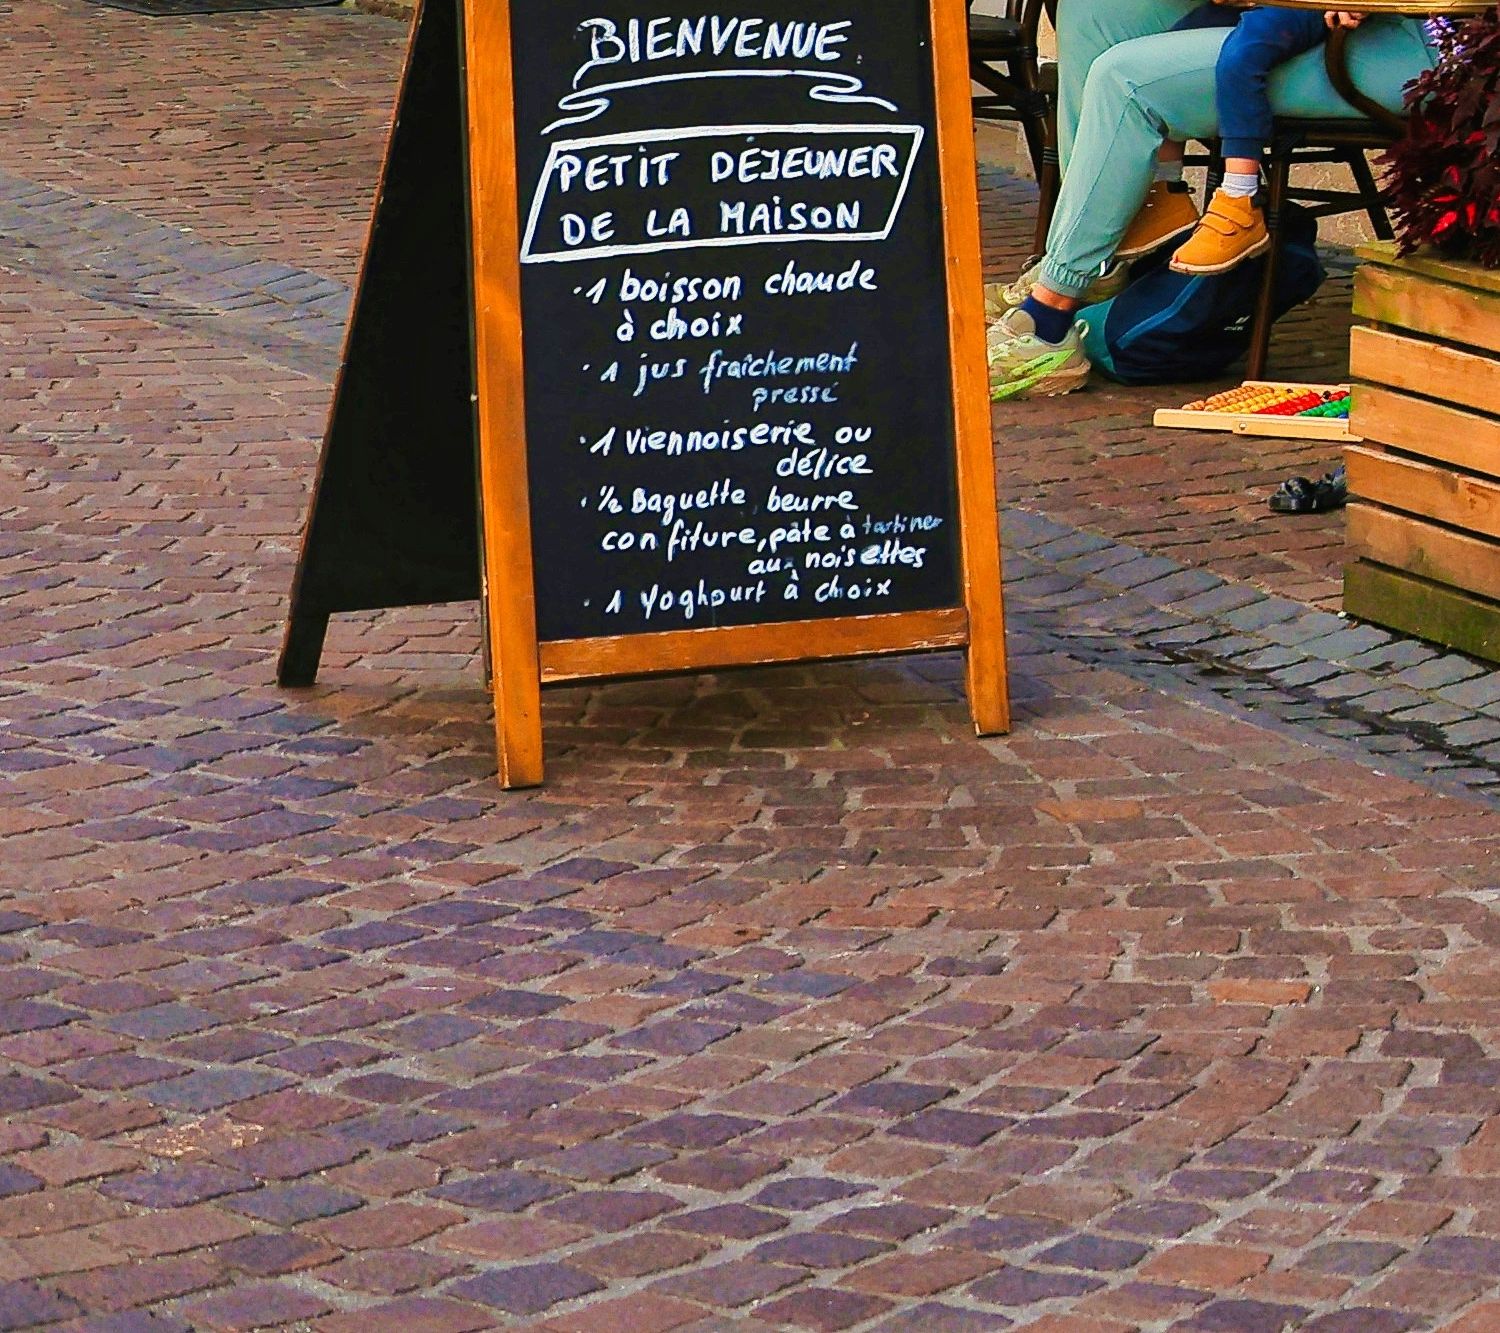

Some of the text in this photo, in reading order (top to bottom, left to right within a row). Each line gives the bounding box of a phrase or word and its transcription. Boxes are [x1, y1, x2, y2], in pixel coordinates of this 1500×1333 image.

[574, 16, 853, 85] BIENVENUE
[560, 211, 615, 245] DE
[646, 207, 690, 236] LA
[619, 268, 742, 303] boisson
[764, 259, 879, 297] chaude
[616, 307, 743, 343] à choix
[633, 353, 688, 397] jus
[834, 424, 873, 445] ou
[775, 447, 874, 481] délice
[631, 478, 747, 526] Baguette
[767, 485, 860, 513] beurre
[804, 540, 927, 571] noisettes
[814, 575, 892, 605] choix
